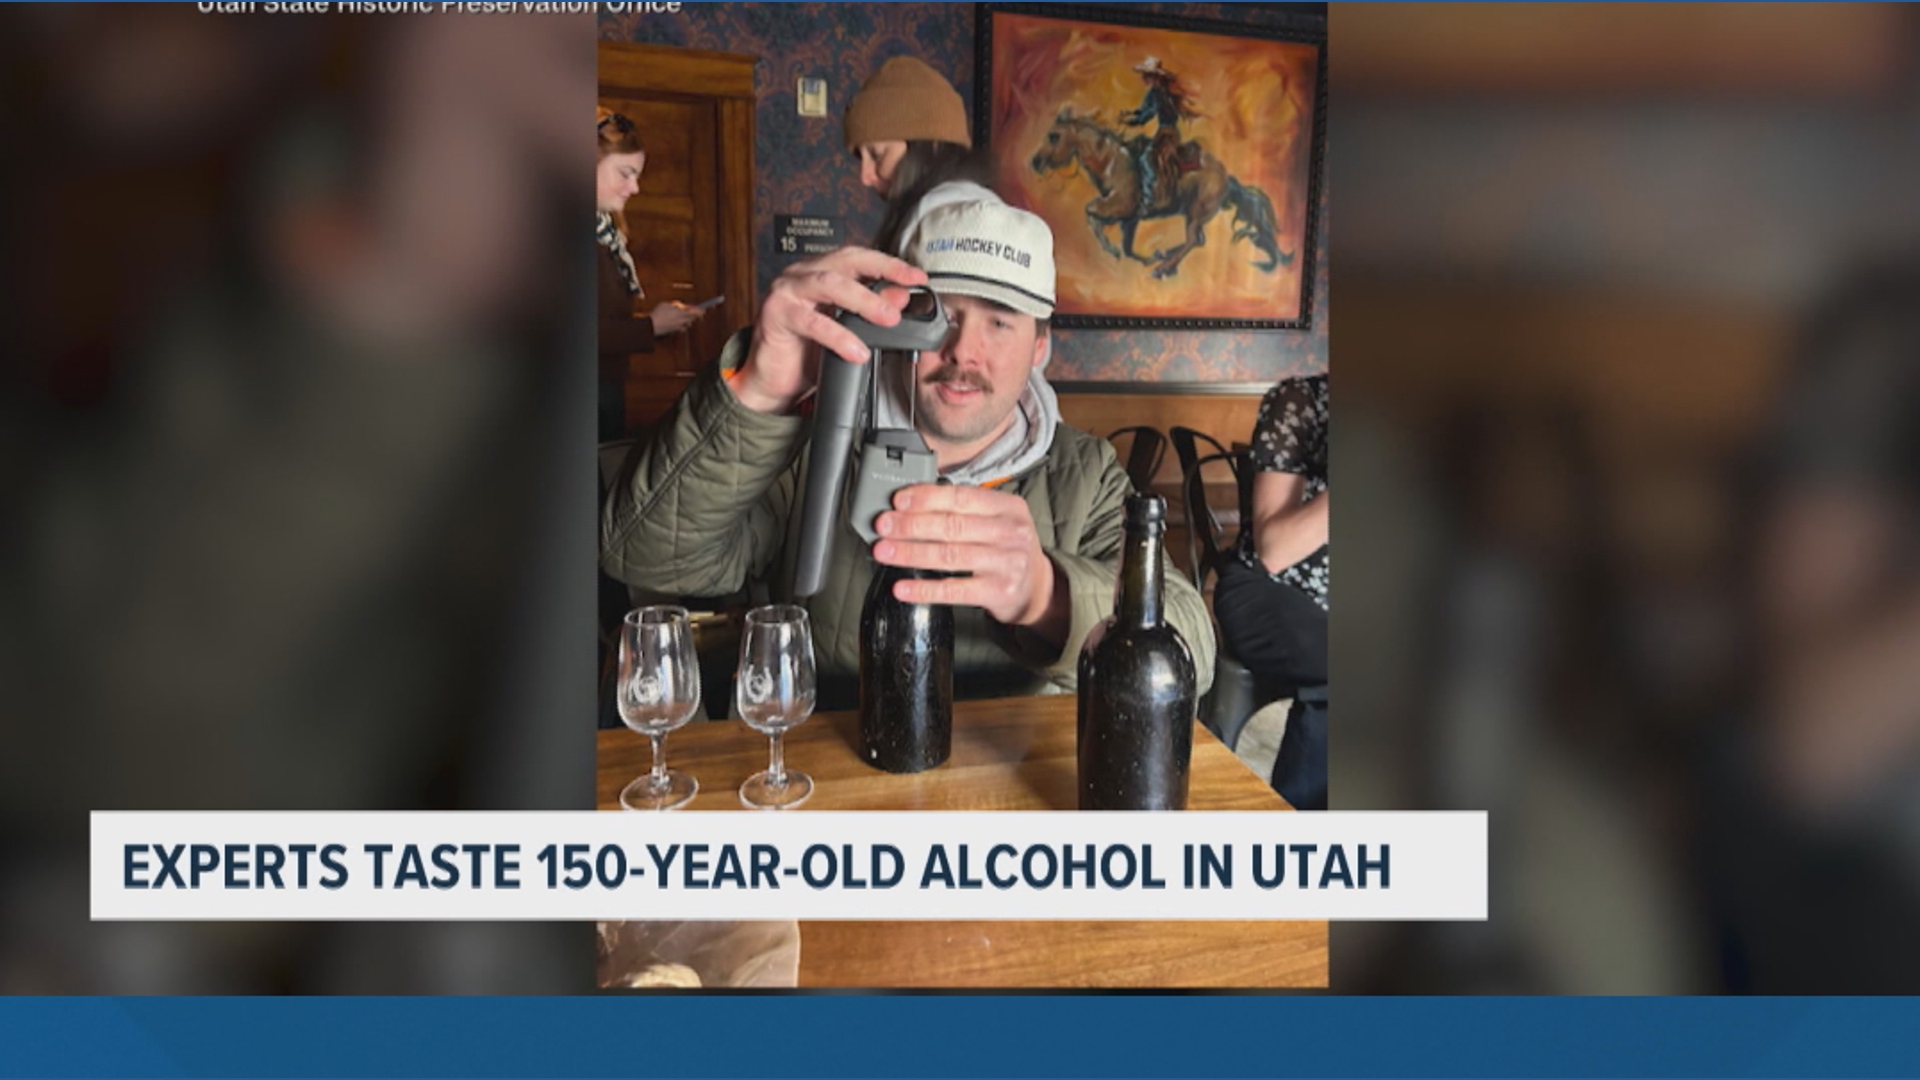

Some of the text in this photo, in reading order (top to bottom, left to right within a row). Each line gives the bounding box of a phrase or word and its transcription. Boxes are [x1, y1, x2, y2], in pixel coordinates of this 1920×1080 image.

[791, 217, 829, 227] MAXIMUM
[786, 226, 834, 237] OCCUPANCY
[781, 236, 797, 252] 15
[955, 238, 1002, 257] HOCKEY
[1002, 244, 1032, 268] CLUB
